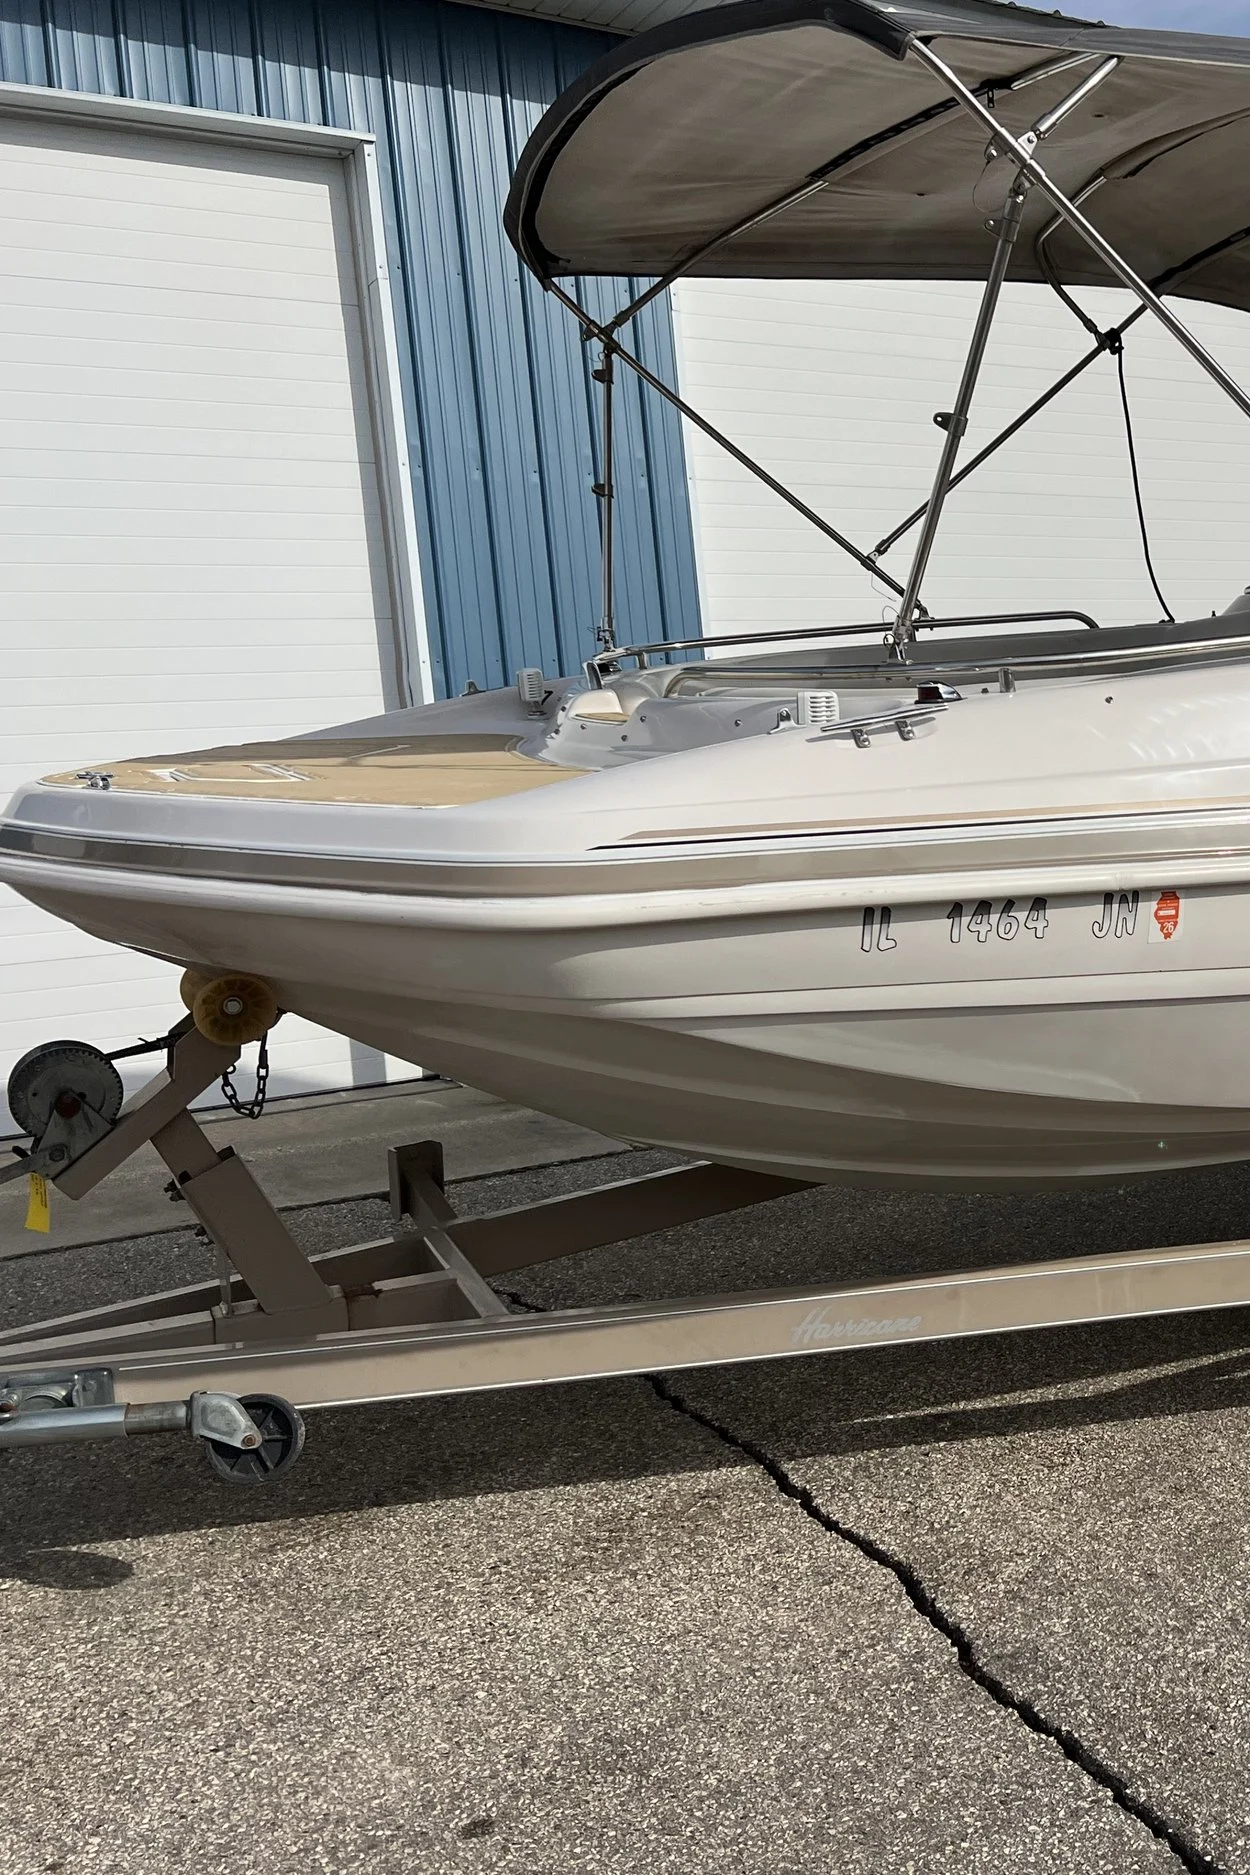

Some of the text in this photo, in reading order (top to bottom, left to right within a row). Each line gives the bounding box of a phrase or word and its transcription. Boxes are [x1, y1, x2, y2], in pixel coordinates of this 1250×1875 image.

[861, 906, 897, 952] IL
[947, 893, 1048, 943] 1464
[1092, 889, 1139, 938] JN
[1163, 922, 1174, 933] 26
[791, 1306, 922, 1344] Hurricane
